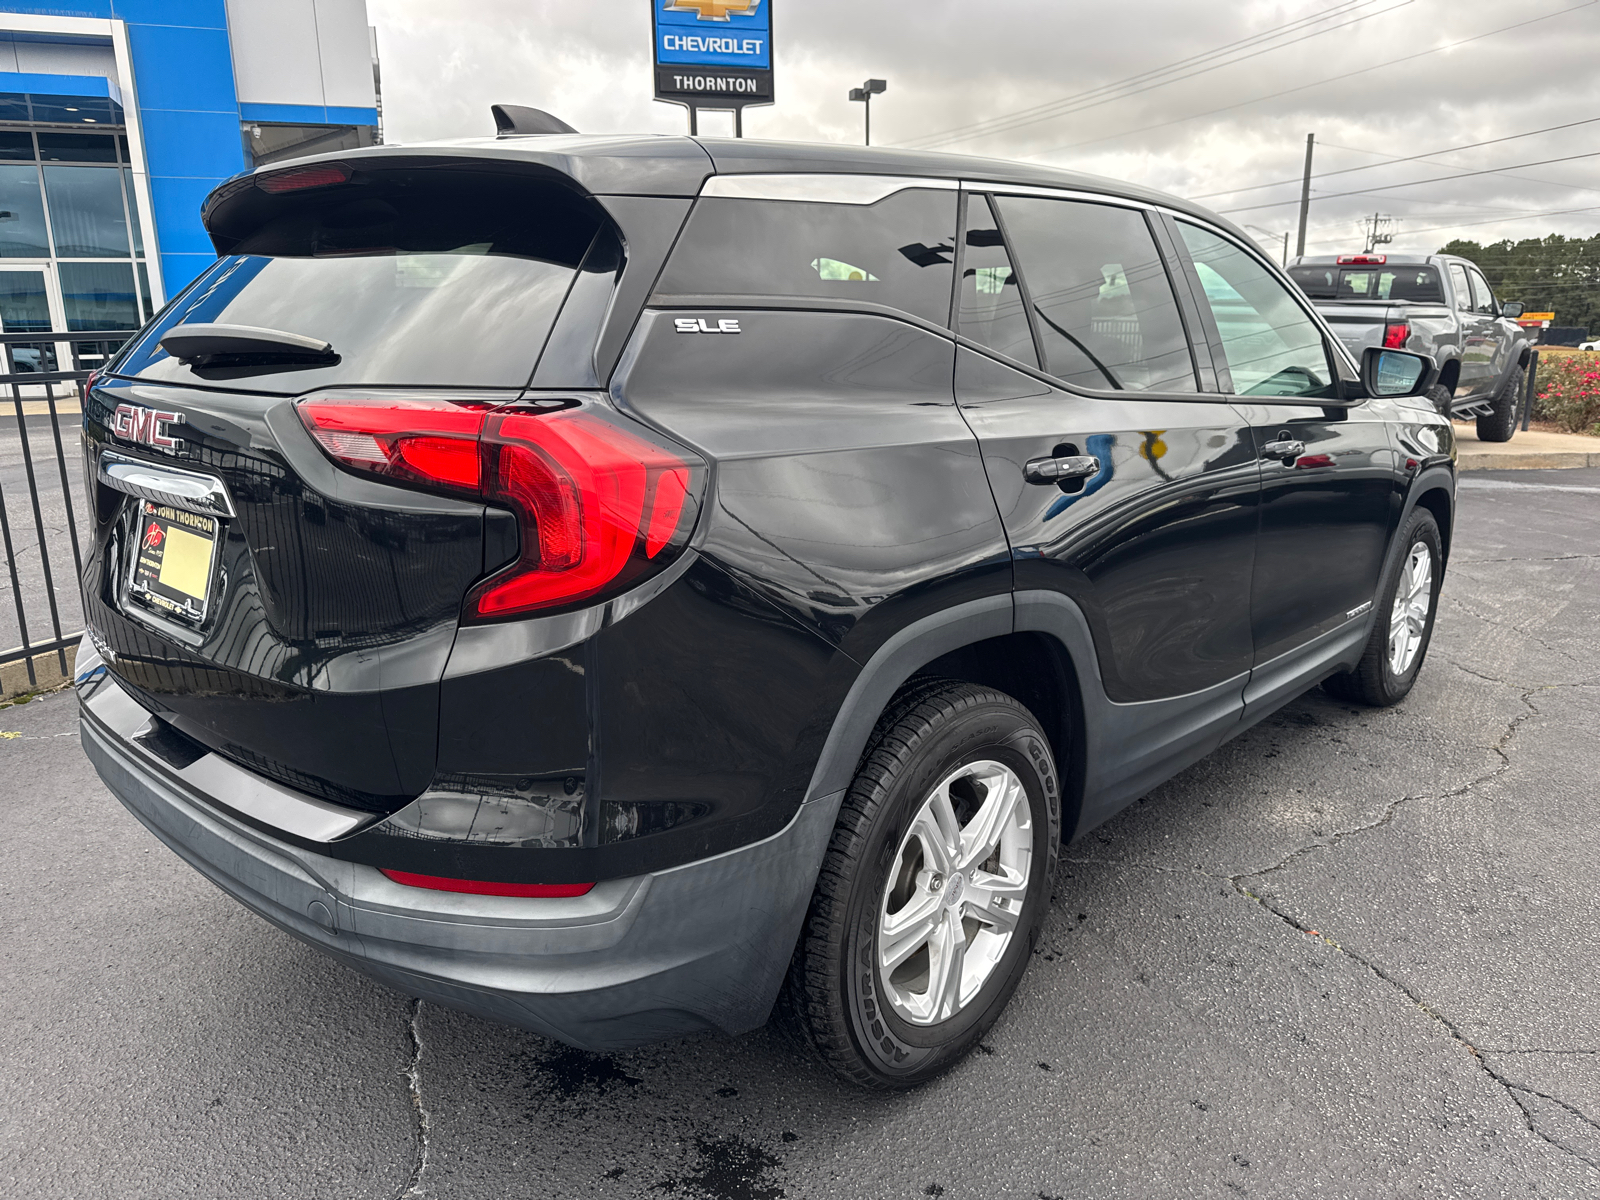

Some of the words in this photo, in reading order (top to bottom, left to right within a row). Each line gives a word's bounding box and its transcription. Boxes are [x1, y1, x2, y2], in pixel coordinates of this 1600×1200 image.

[663, 35, 763, 54] CHEVROLET
[673, 76, 757, 92] THORNTON
[674, 318, 741, 334] SLE
[114, 403, 185, 450] GMC
[157, 507, 175, 521] JOHN
[176, 510, 213, 532] THORNTON
[152, 596, 175, 610] CHEVROLET
[862, 841, 910, 1064] ASSURANCE
